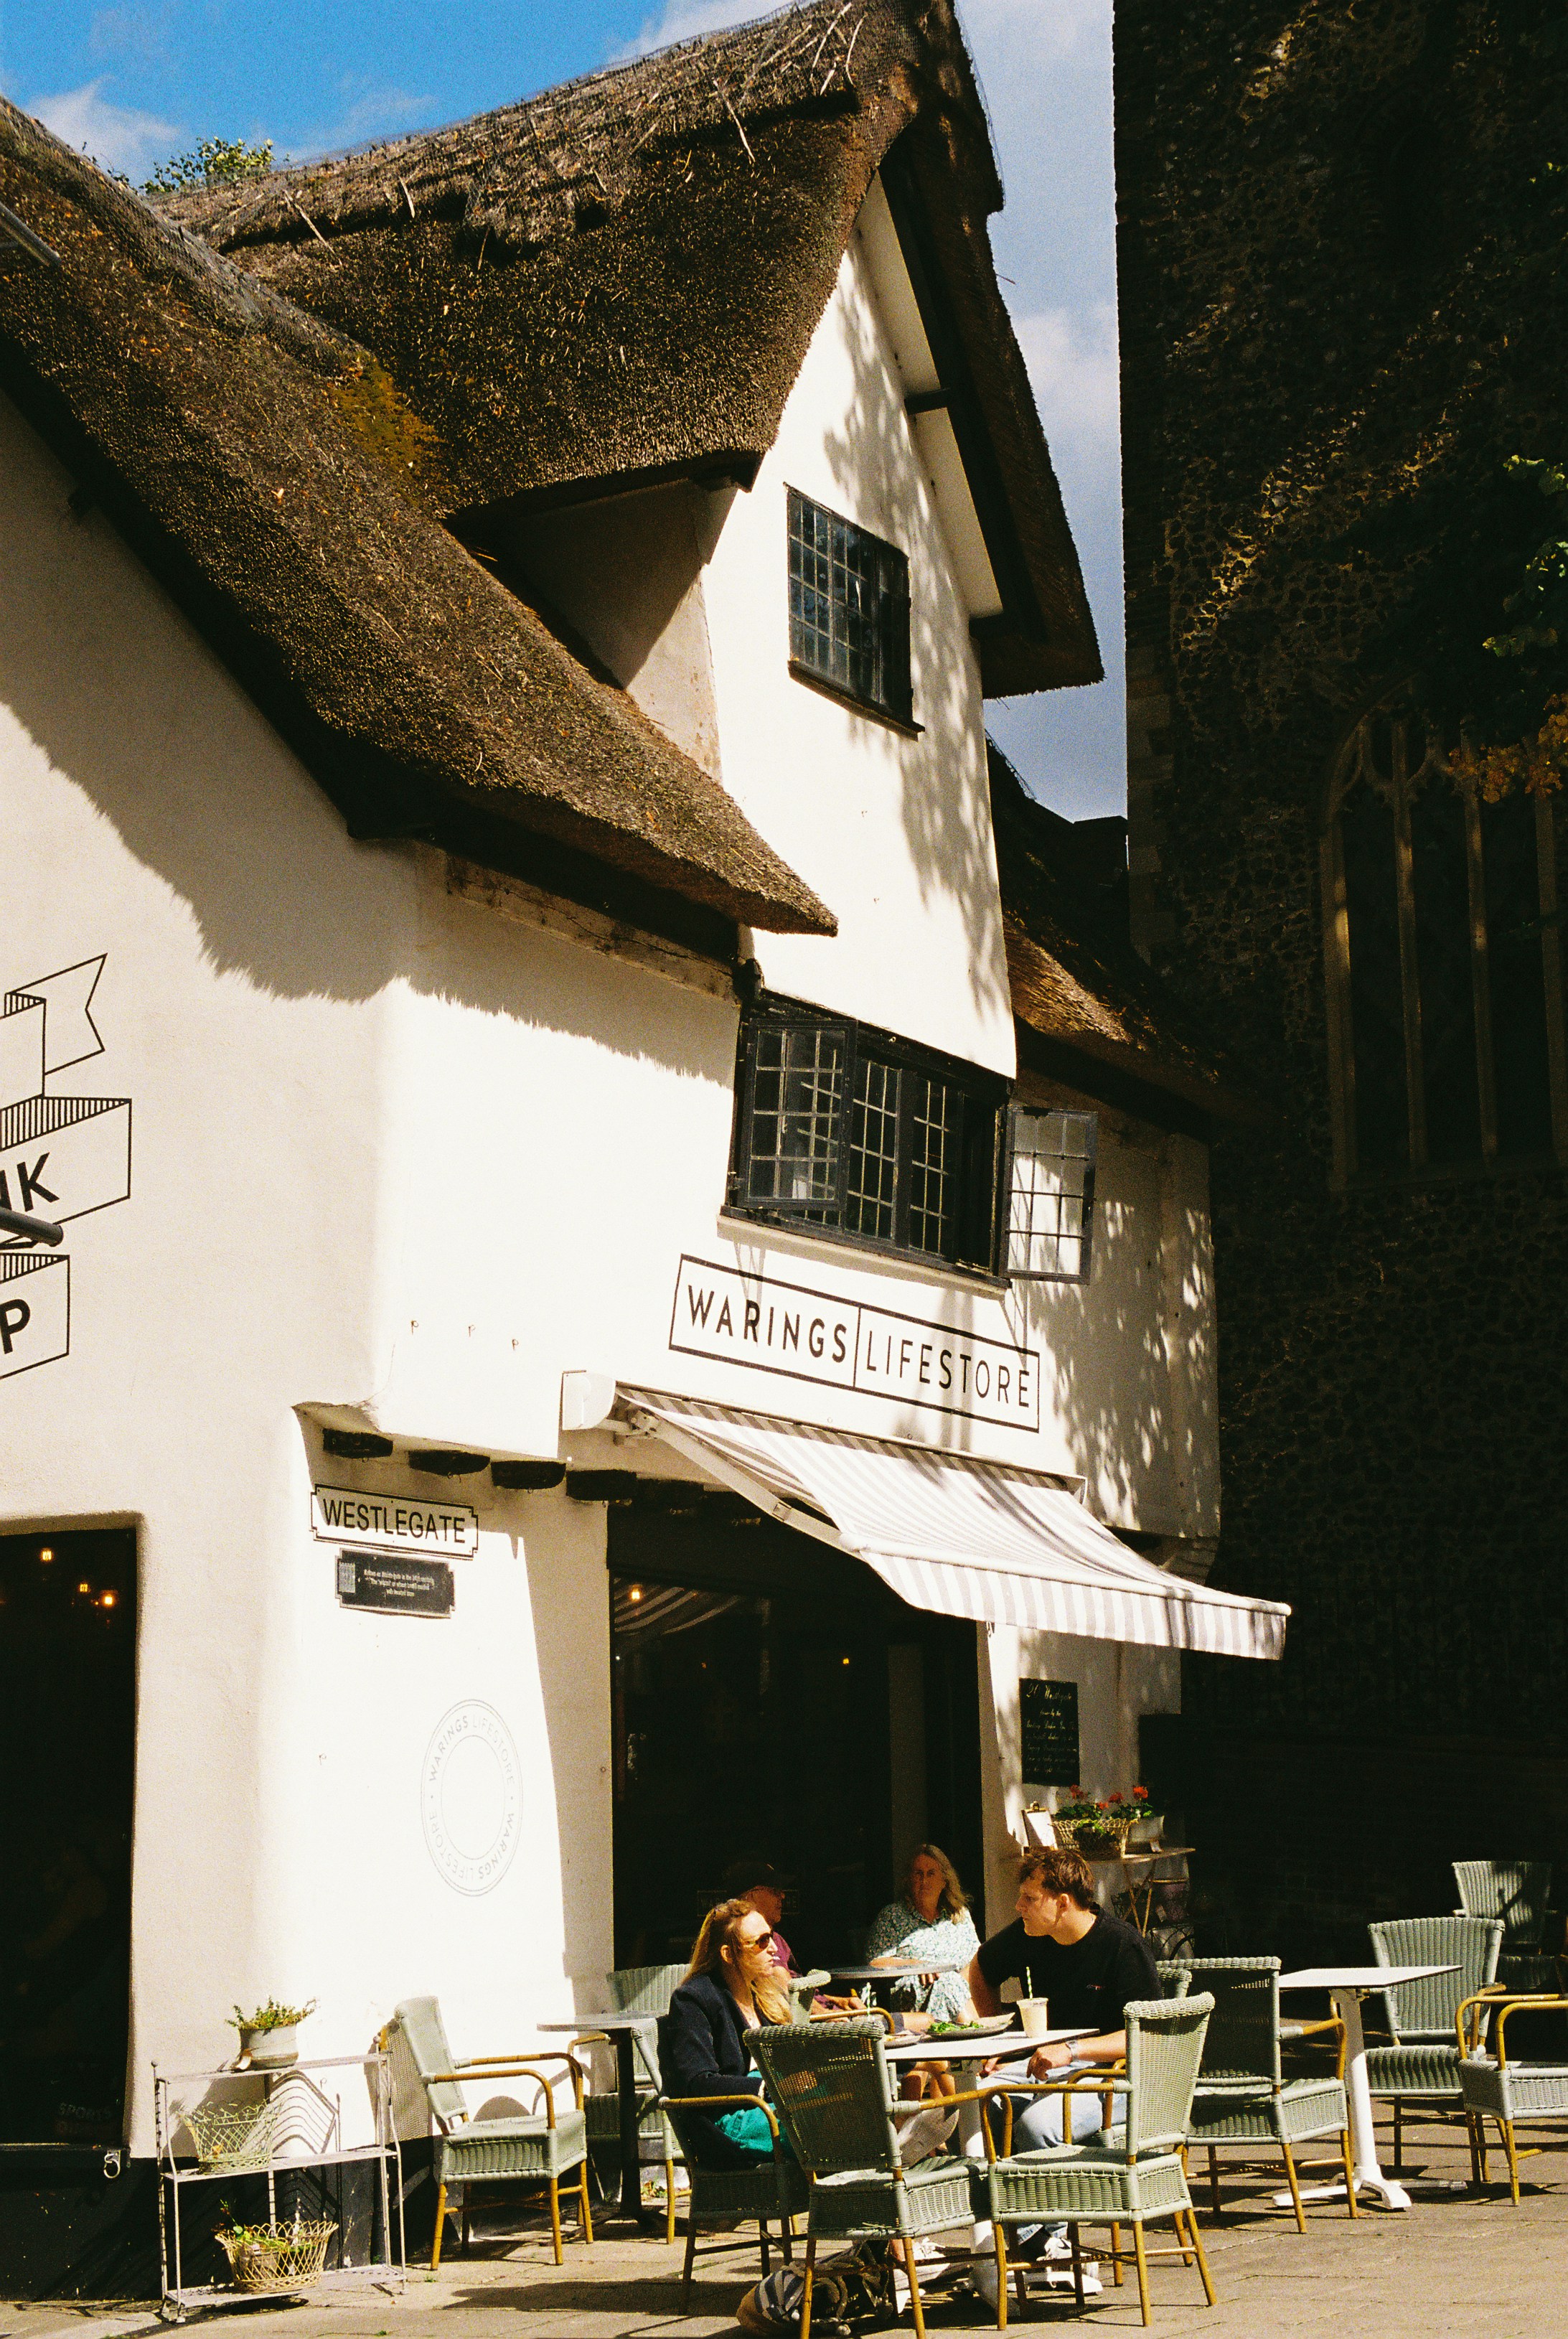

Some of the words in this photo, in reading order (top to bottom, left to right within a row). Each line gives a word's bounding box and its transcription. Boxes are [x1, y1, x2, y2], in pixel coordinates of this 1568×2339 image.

[687, 1284, 847, 1363] WARINGS
[865, 1330, 1030, 1407] LIFESTORE
[322, 1498, 466, 1544] WESTLEGATE
[428, 1715, 469, 1782] WARINGS
[472, 1714, 516, 1786] LIFESTORE
[428, 1809, 474, 1882] LIFESTORE
[477, 1812, 515, 1880] WARINGS
